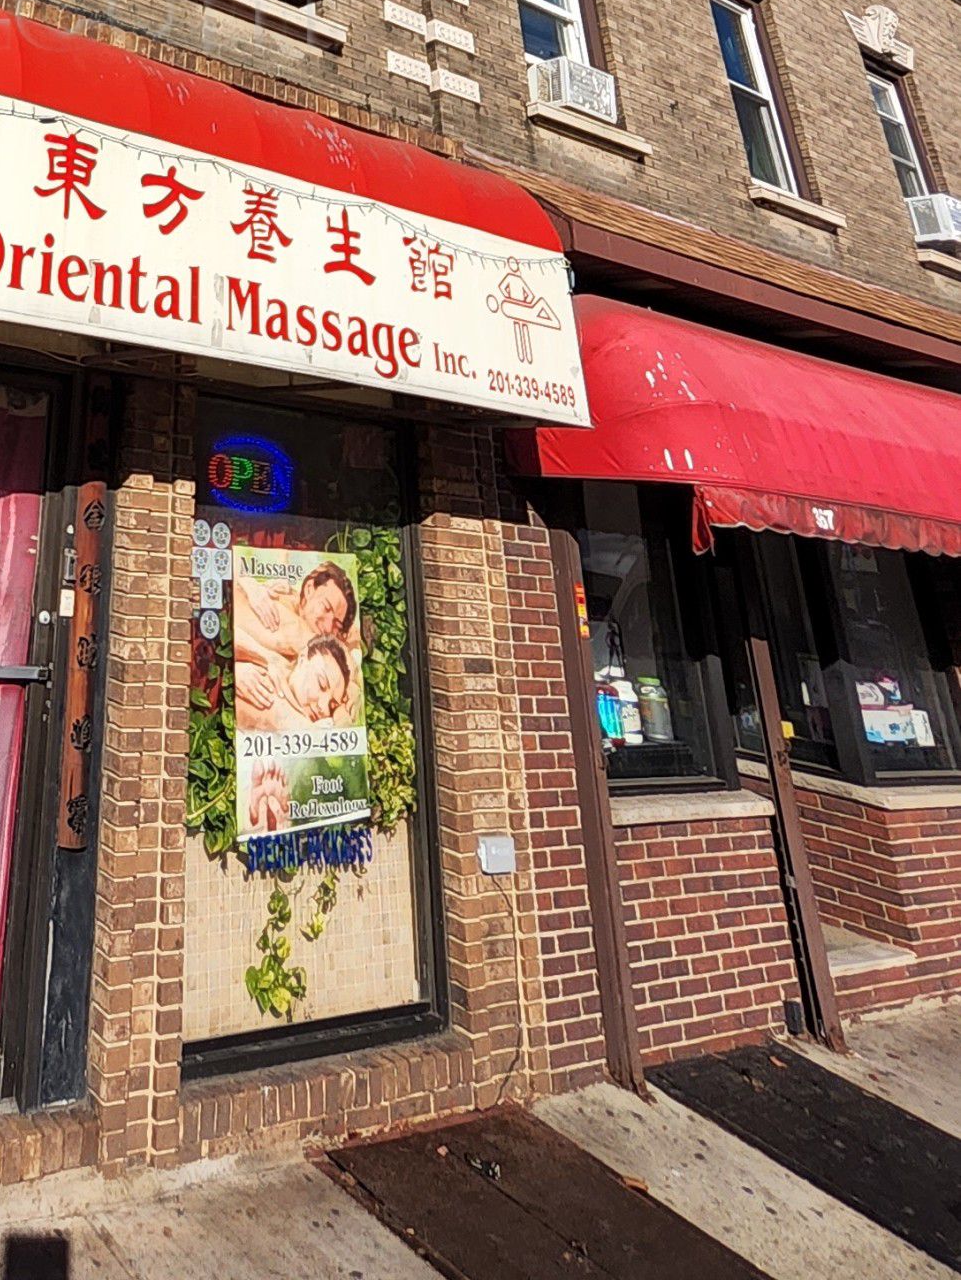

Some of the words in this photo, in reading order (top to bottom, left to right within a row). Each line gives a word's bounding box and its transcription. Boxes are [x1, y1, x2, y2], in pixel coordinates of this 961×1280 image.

[34, 133, 454, 300] 東方養生館
[226, 276, 422, 379] Massage
[433, 342, 476, 380] Inc.
[487, 370, 576, 408] 201-339-4589
[812, 507, 835, 530] 367
[239, 556, 304, 584] Massage
[243, 731, 359, 757] 201-339-4589
[311, 775, 343, 795] Foot
